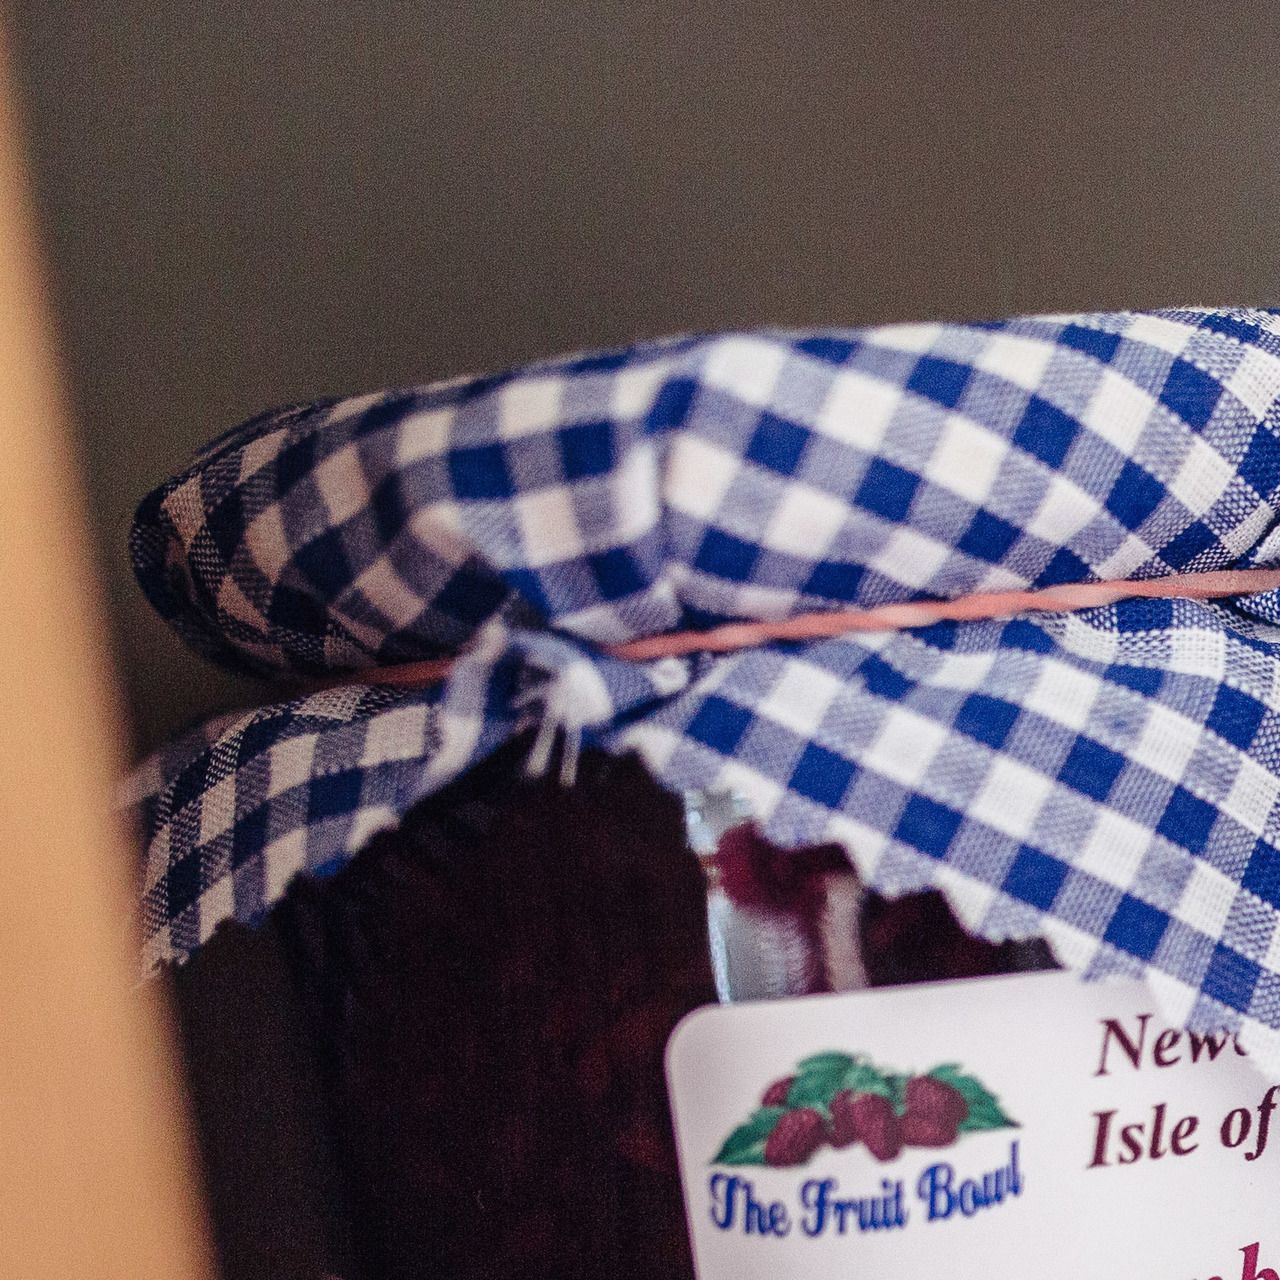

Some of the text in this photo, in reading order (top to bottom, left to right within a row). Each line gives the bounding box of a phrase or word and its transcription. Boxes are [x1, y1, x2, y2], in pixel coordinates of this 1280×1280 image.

[1085, 1101, 1200, 1169] Isle
[709, 1138, 1024, 1238] The Fruit Bowl
